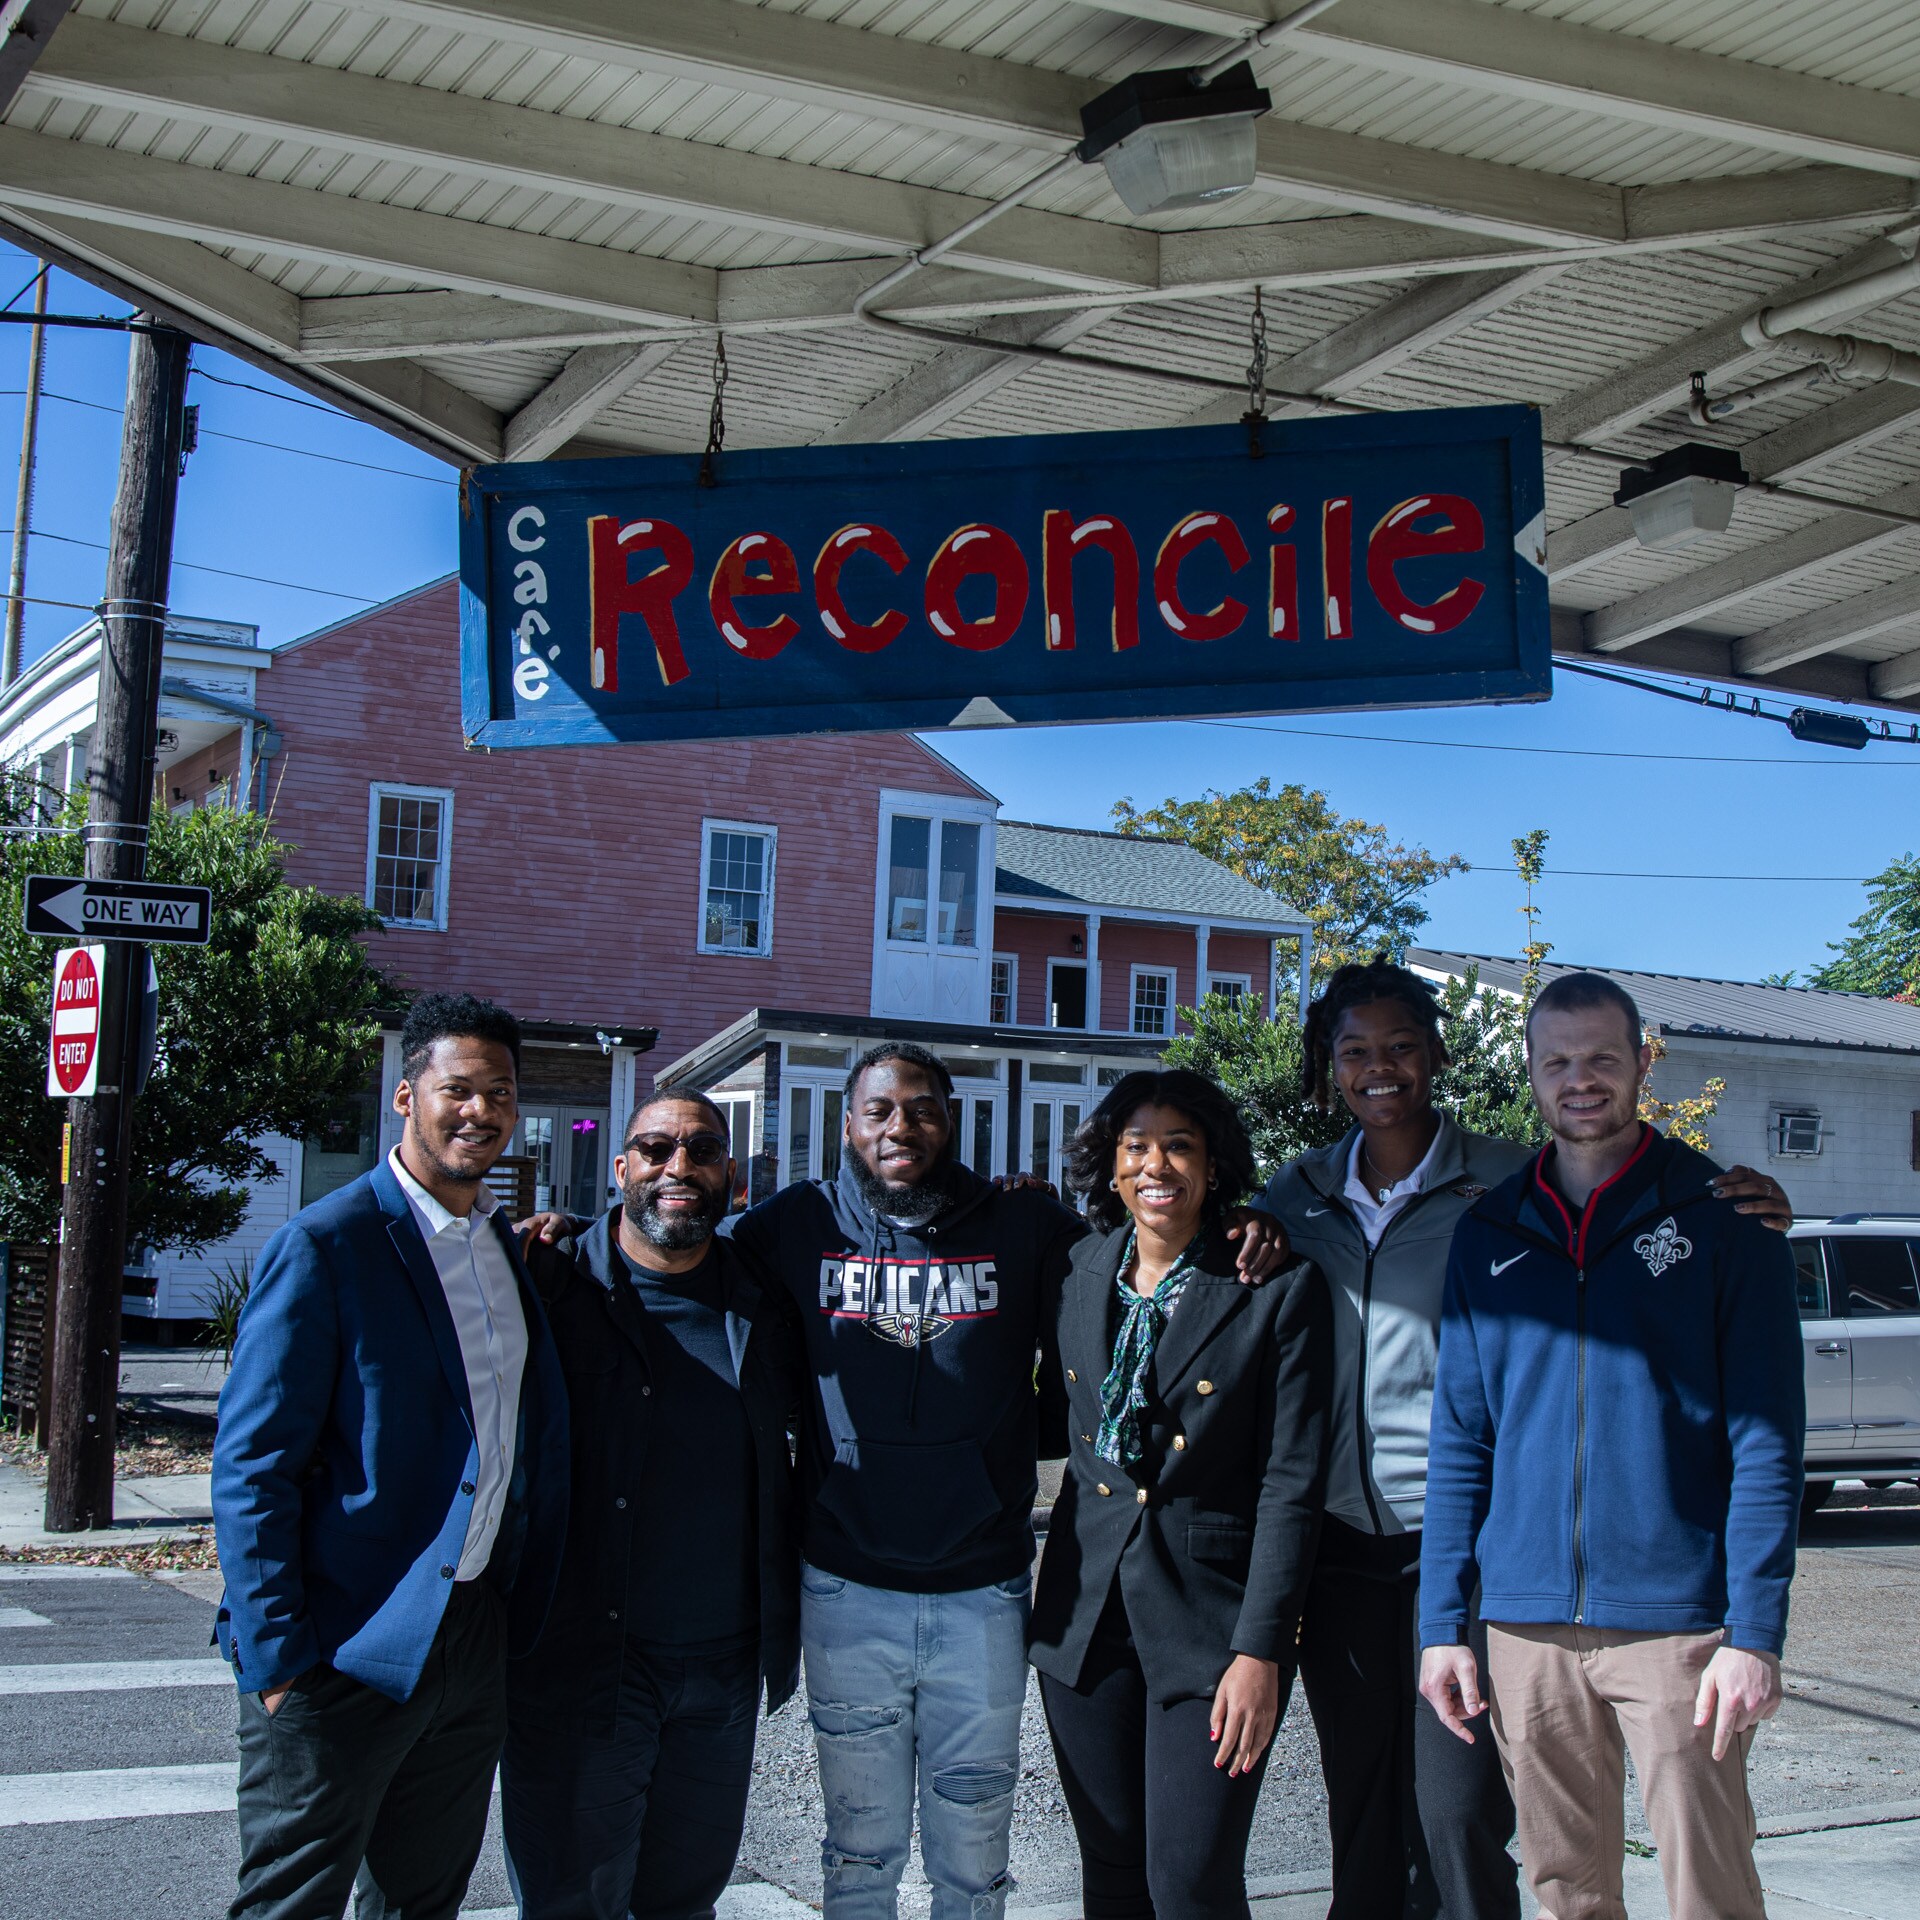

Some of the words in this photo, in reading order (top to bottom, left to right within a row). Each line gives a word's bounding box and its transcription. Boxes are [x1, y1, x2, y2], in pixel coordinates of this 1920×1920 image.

[587, 493, 1485, 693] Reconcile
[83, 898, 132, 921] ONE
[141, 902, 190, 924] WAY
[60, 980, 73, 1001] DO
[76, 977, 95, 999] NOT
[59, 1042, 87, 1065] ENTER
[818, 1259, 999, 1314] PELICANS
